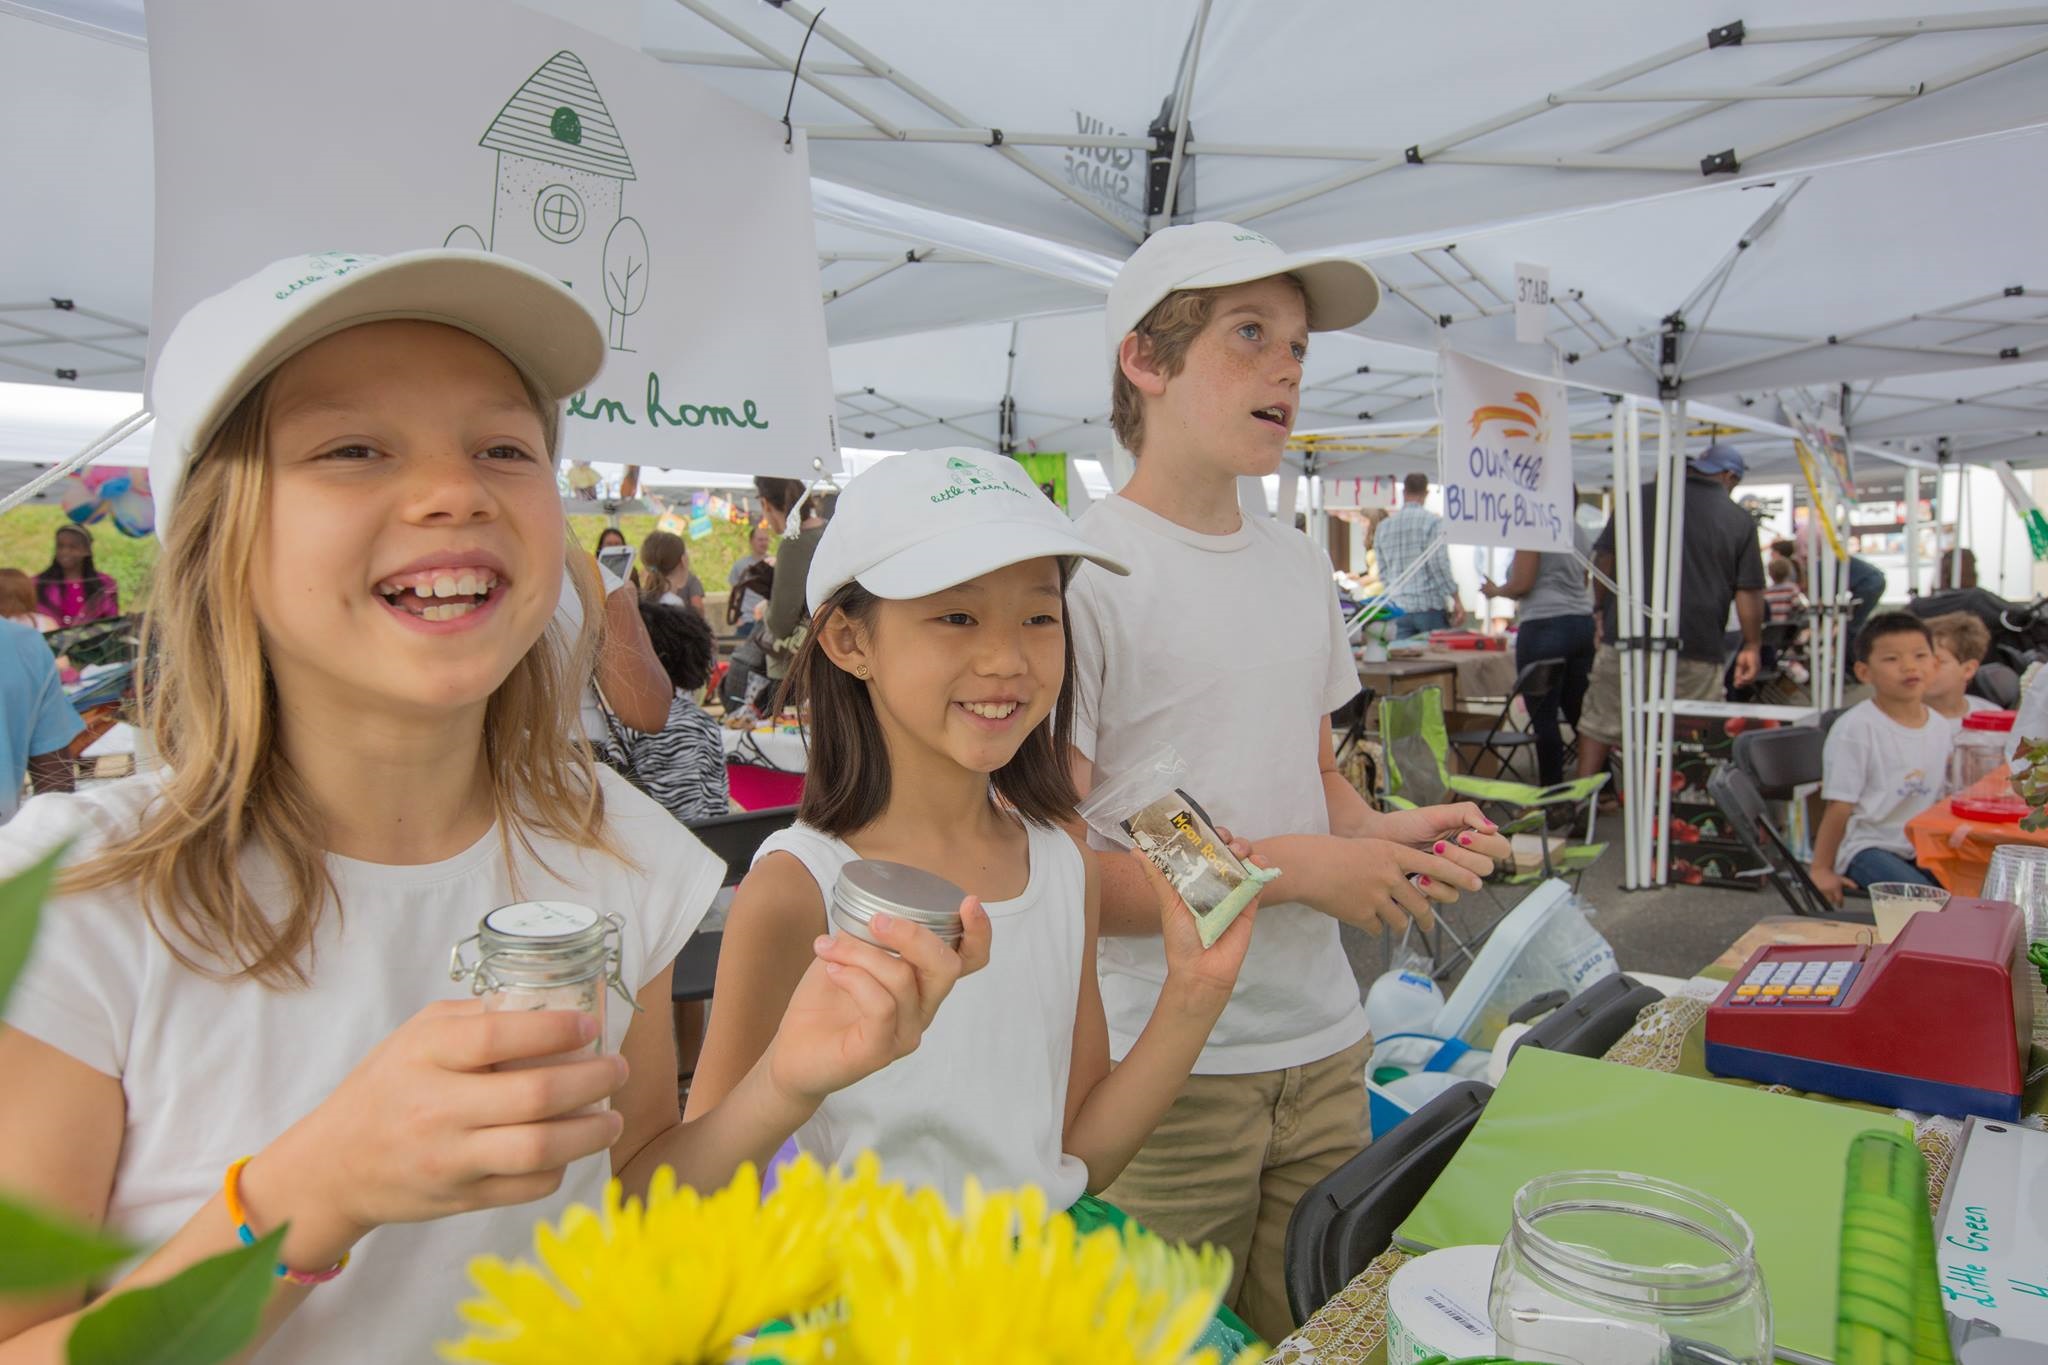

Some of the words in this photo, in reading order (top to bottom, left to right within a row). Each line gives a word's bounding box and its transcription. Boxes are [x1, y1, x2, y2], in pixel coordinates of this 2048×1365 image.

[646, 371, 769, 429] home
[931, 487, 965, 503] little
[1171, 811, 1202, 847] Moon
[1201, 843, 1230, 877] Rock
[1946, 1205, 1990, 1252] Green
[1941, 1264, 1998, 1309] Little
